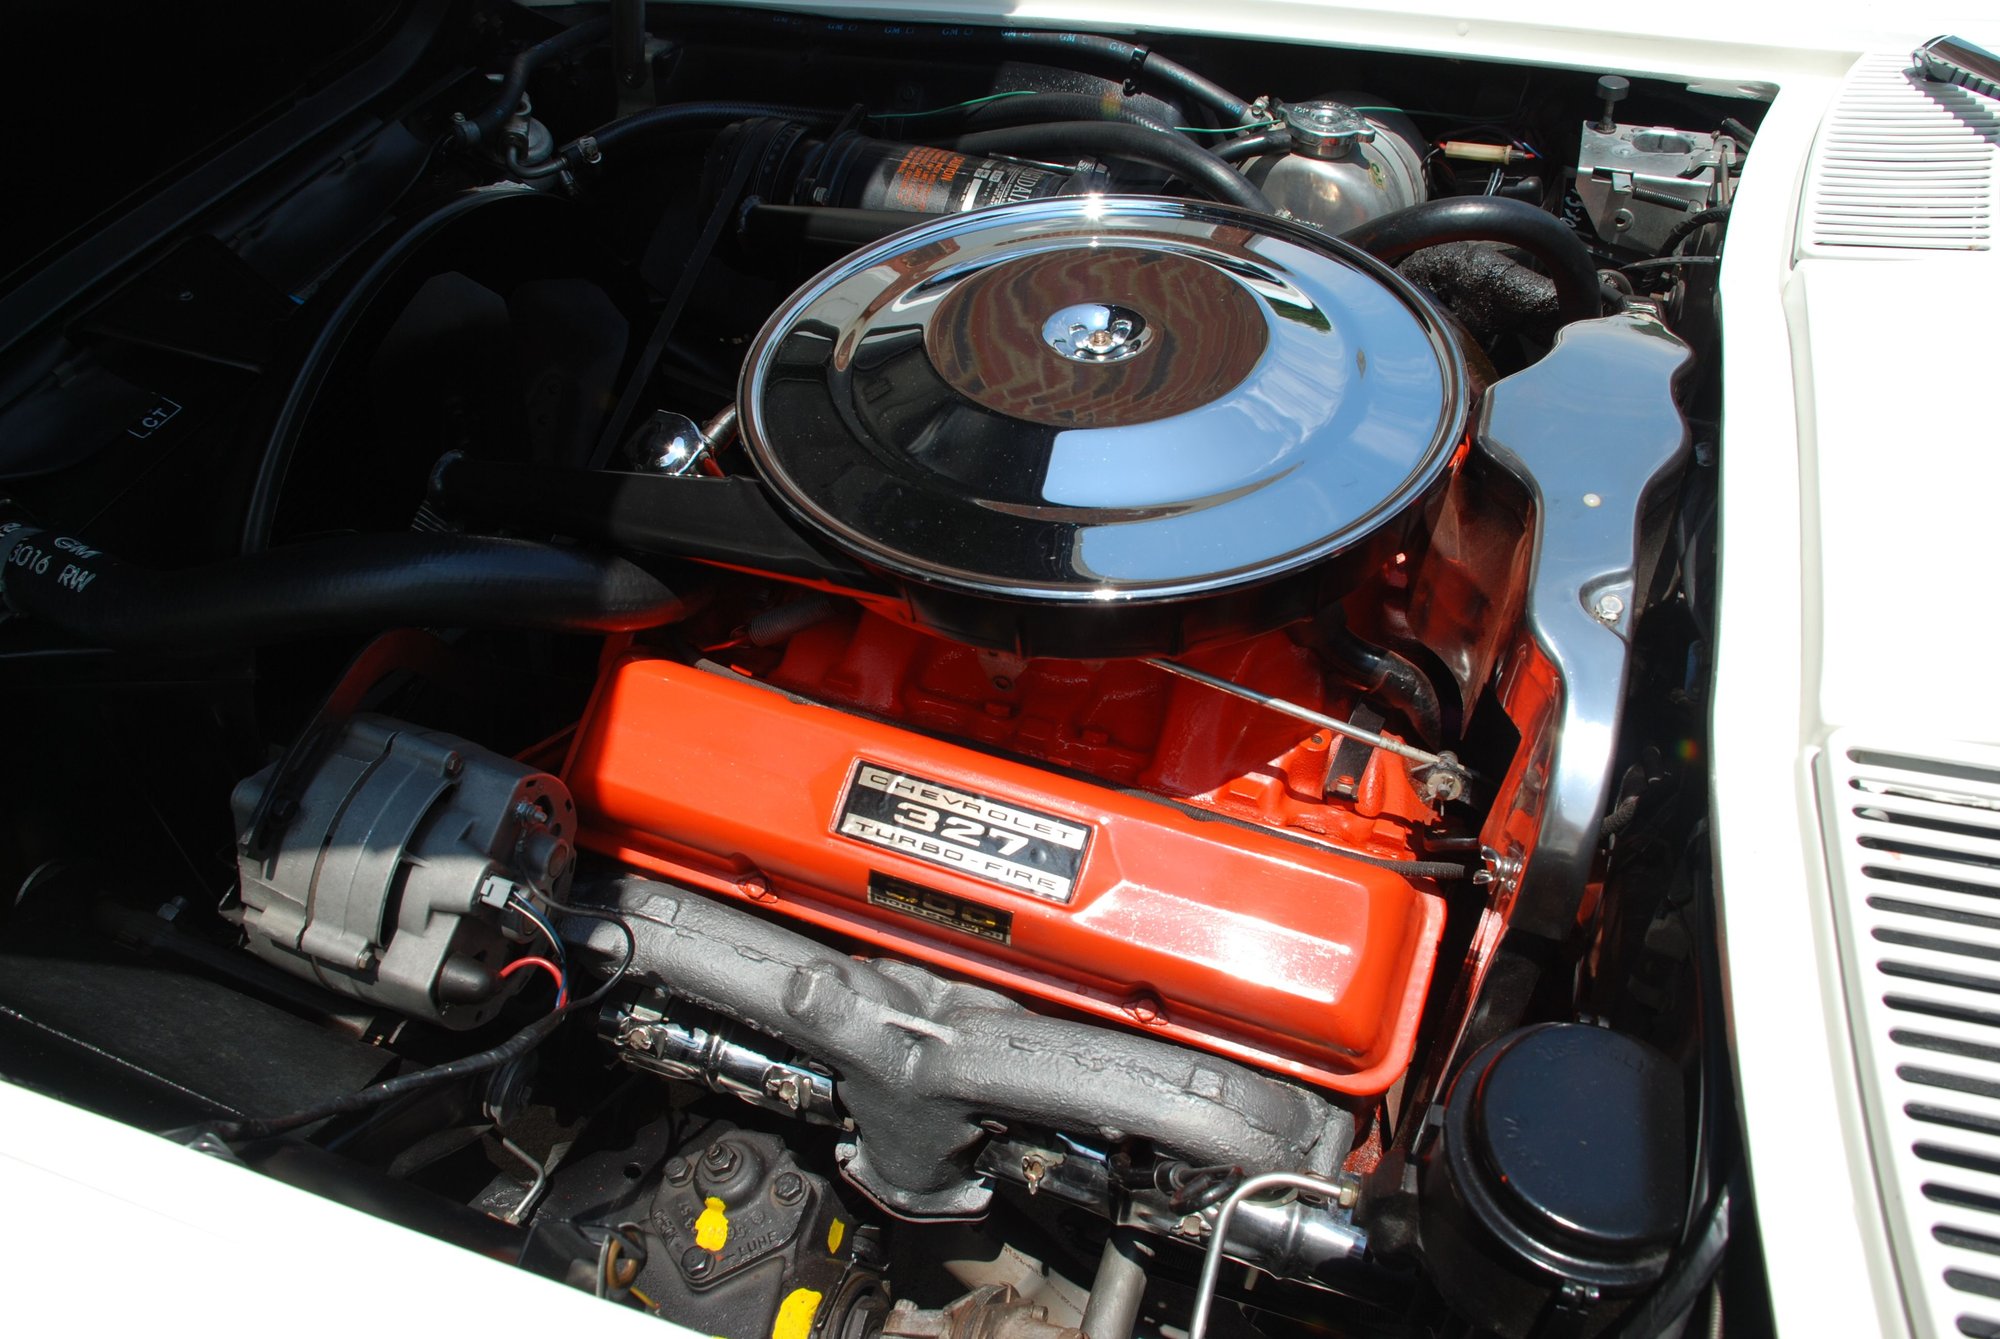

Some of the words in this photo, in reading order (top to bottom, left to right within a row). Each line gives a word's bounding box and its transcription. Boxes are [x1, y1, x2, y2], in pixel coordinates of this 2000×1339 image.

[884, 26, 902, 34] GM
[942, 27, 961, 36] GM
[1001, 29, 1017, 38] GM
[1058, 33, 1077, 43] GM
[54, 536, 102, 559] GM
[57, 563, 96, 592] RW
[869, 772, 1074, 840] CHEVROLET
[893, 801, 1029, 857] 327
